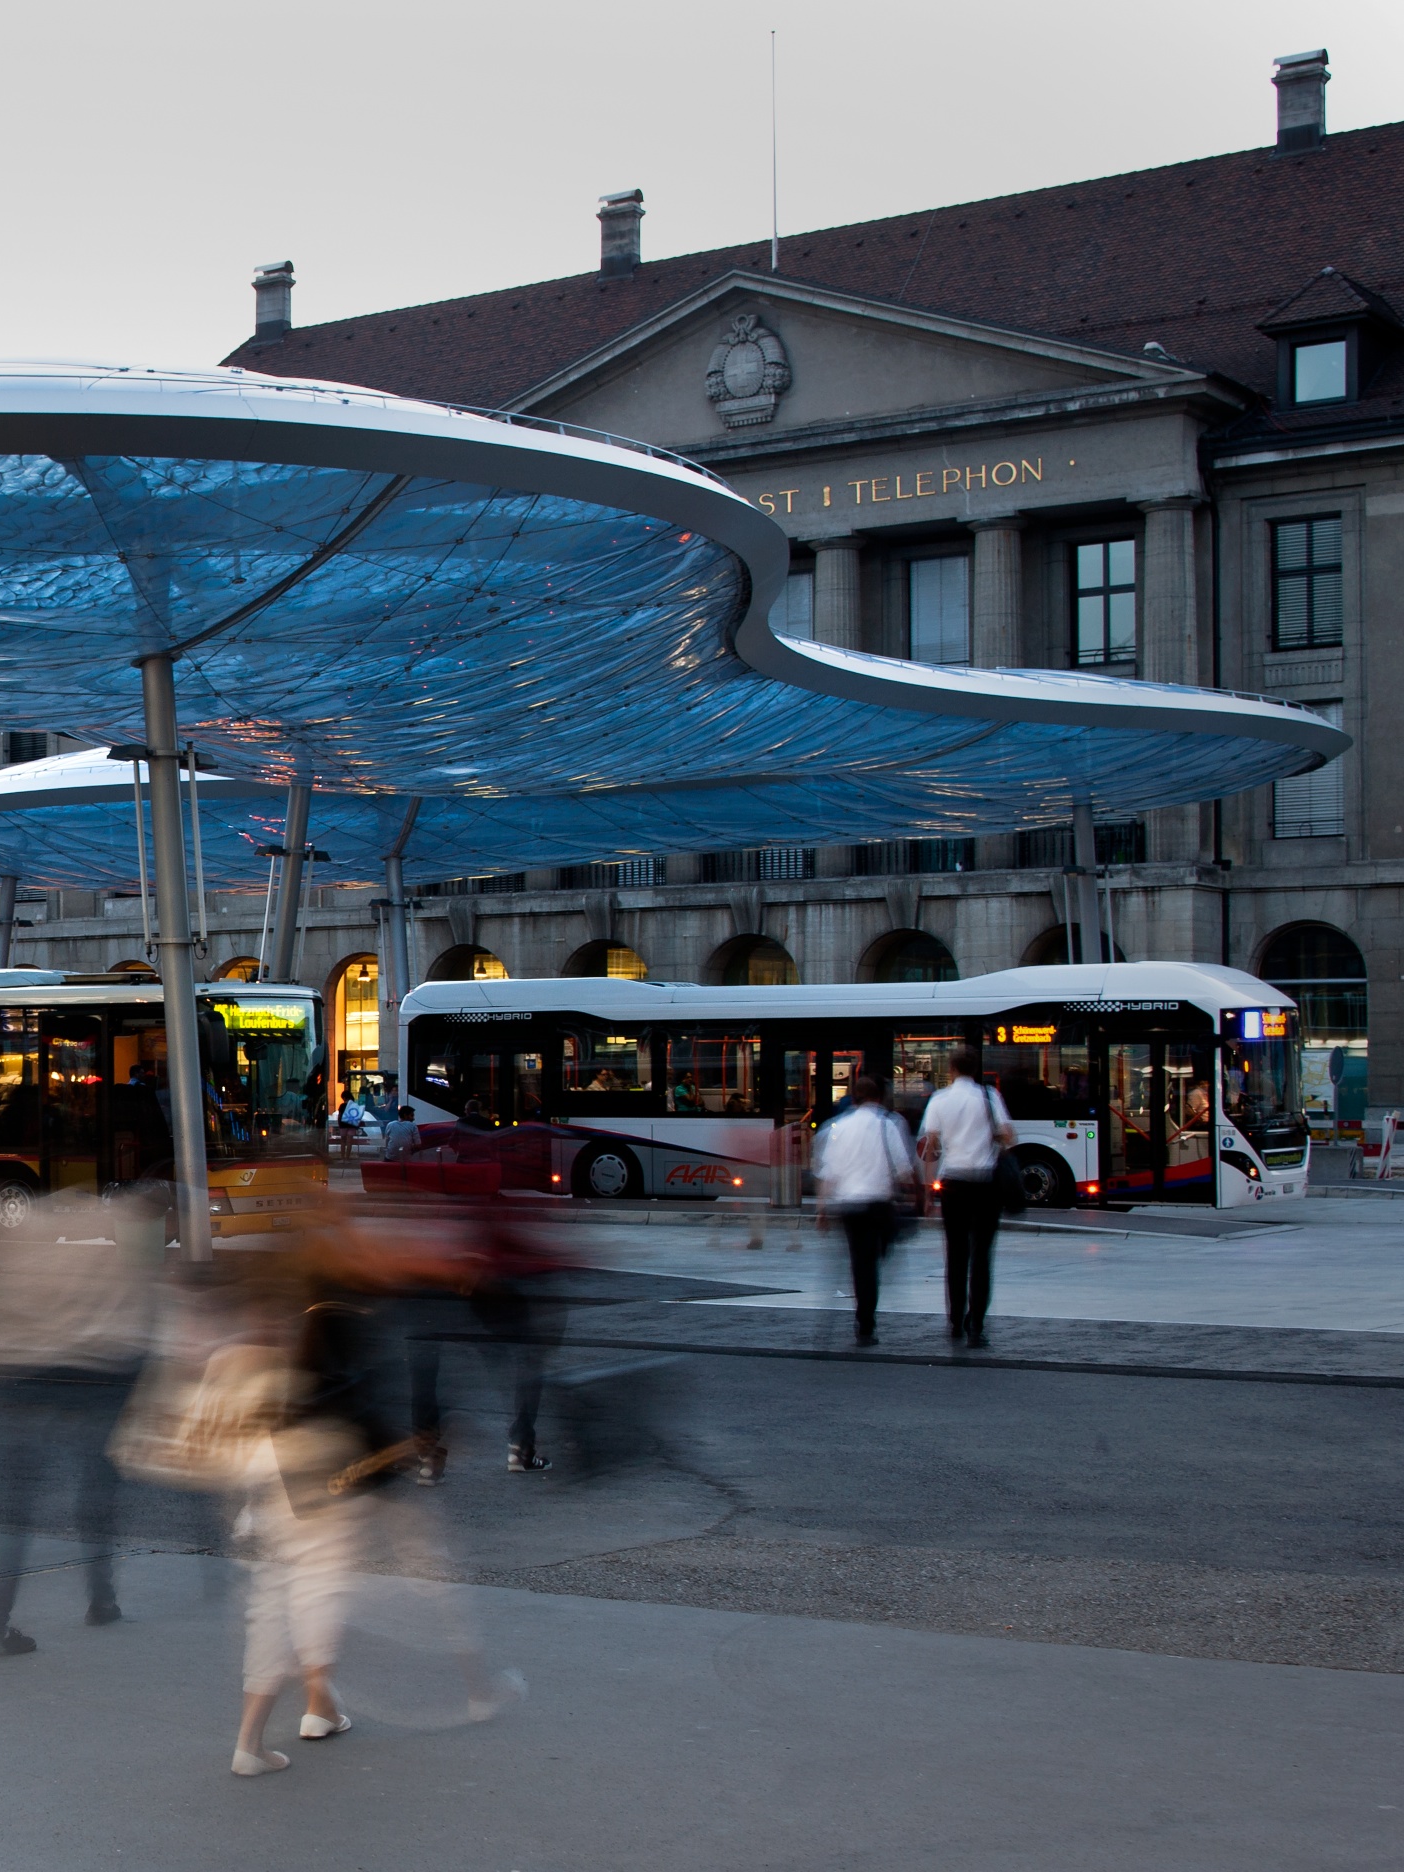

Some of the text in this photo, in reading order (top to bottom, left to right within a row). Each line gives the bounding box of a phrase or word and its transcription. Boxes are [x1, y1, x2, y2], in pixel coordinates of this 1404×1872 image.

[742, 457, 1043, 516] ST TELEPHON
[1120, 1002, 1179, 1010] HYBRID
[239, 1017, 295, 1029] Laufenburg
[997, 1026, 1007, 1043] 3
[1012, 1034, 1052, 1043] Gretzenbach
